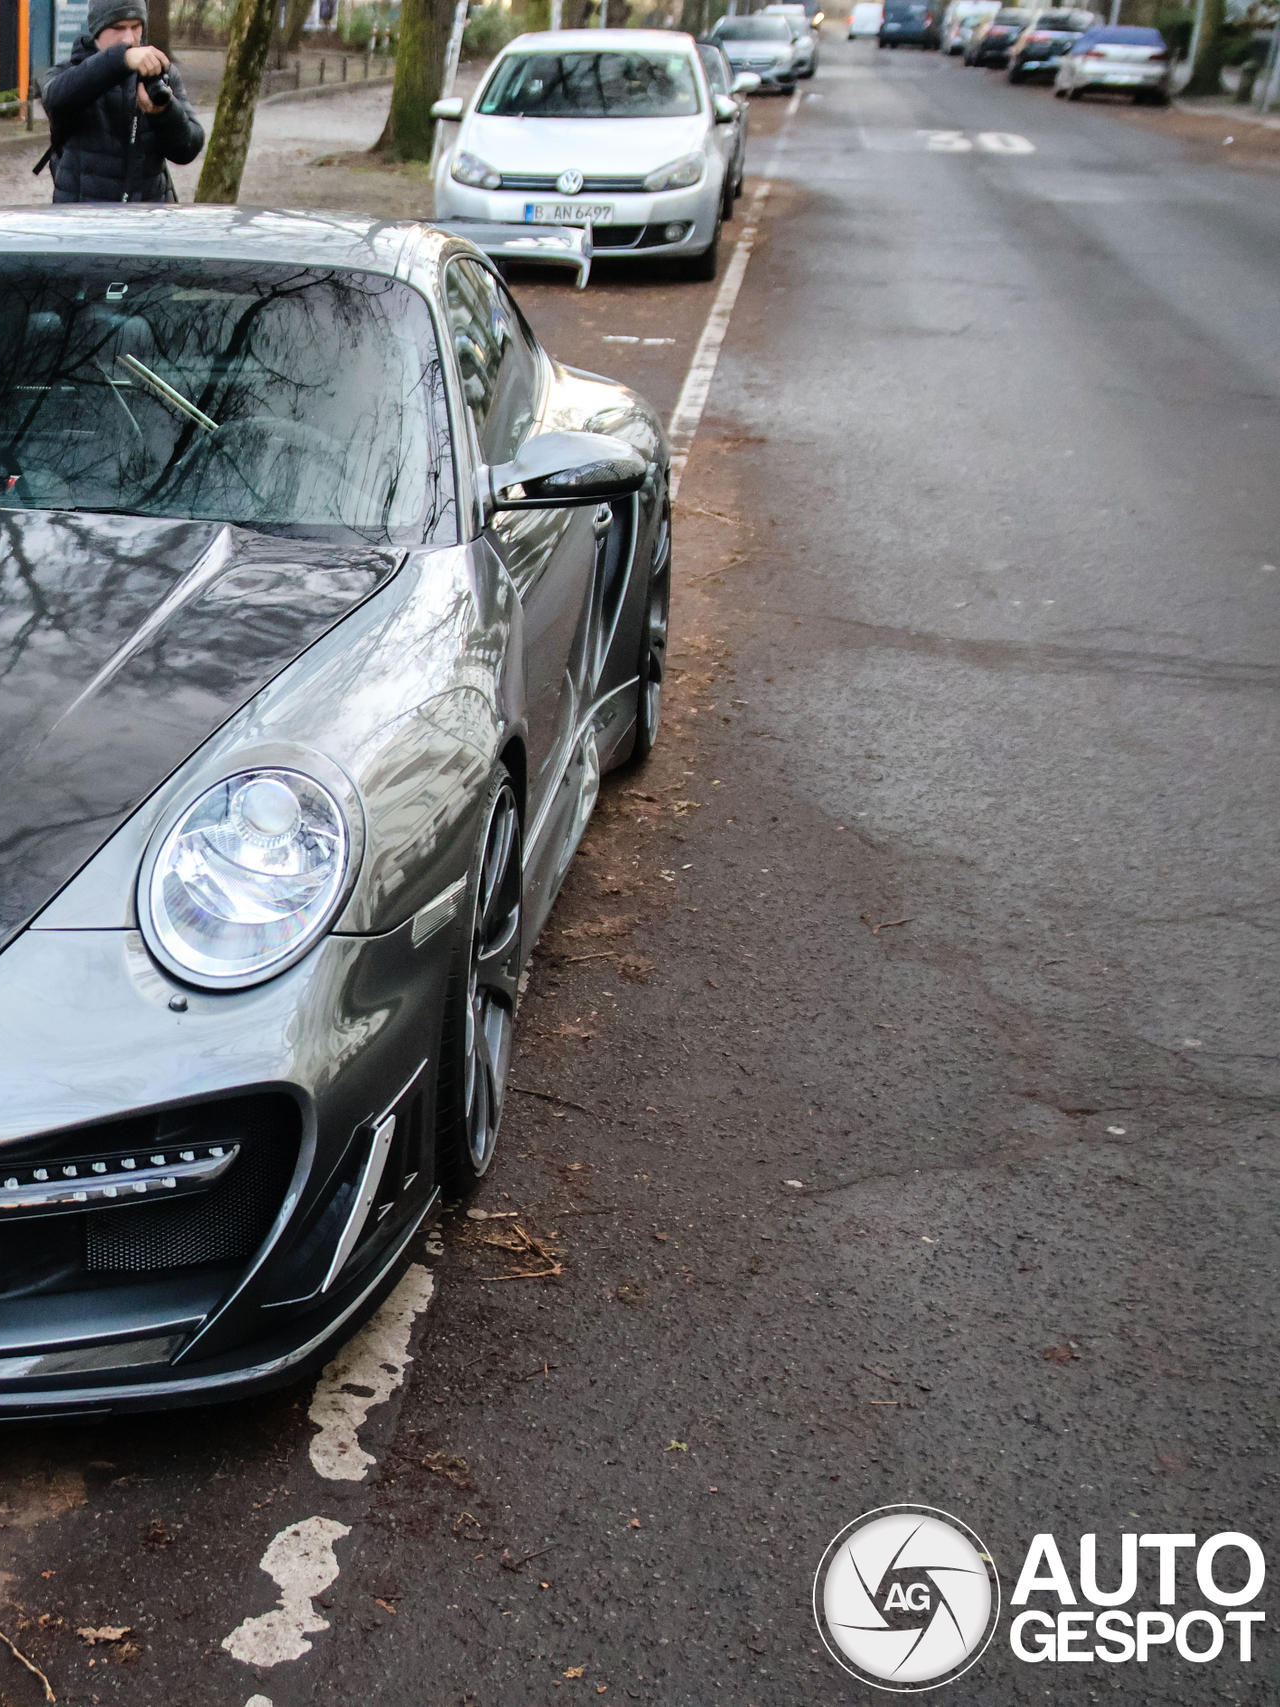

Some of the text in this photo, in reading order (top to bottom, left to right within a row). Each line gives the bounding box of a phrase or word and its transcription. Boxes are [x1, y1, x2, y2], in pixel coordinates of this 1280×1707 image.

[921, 130, 1036, 153] 30
[535, 205, 544, 219] B
[554, 205, 572, 219] AN
